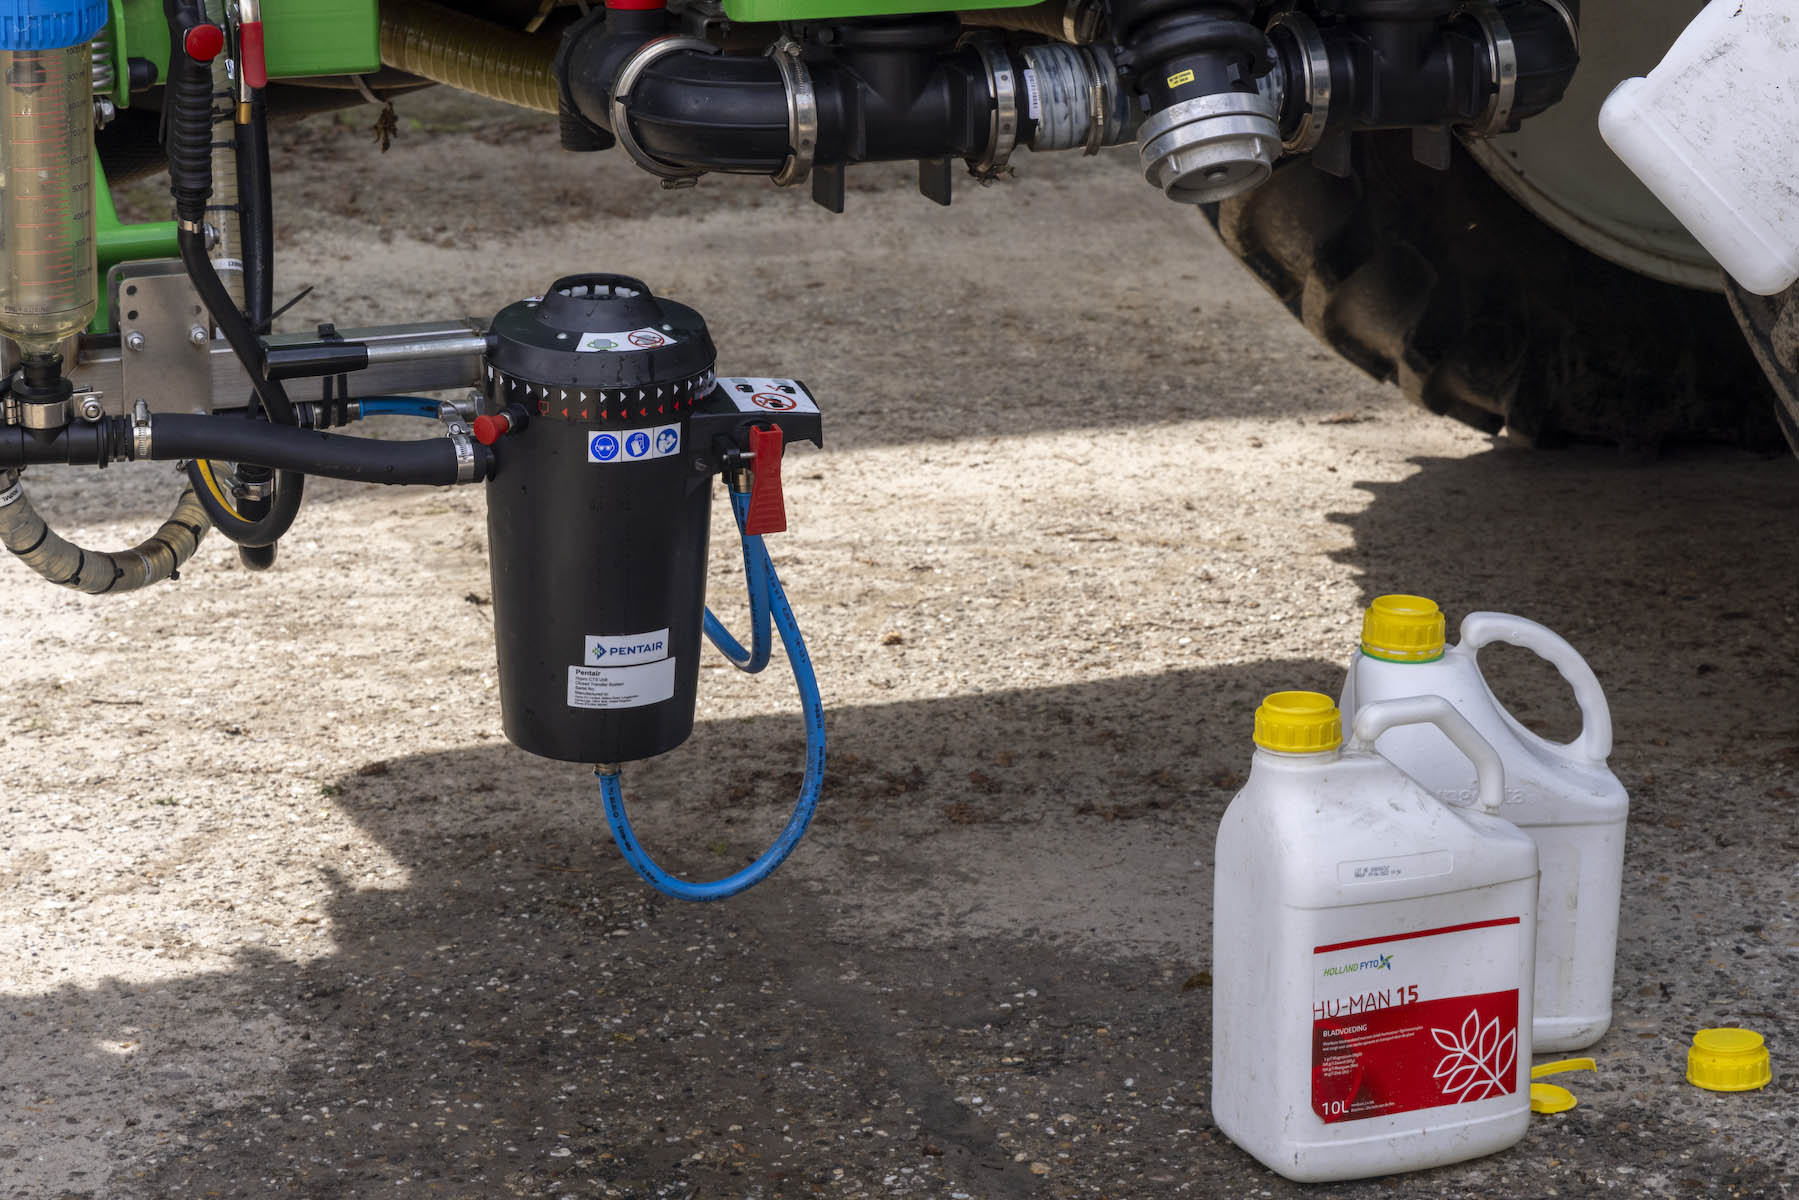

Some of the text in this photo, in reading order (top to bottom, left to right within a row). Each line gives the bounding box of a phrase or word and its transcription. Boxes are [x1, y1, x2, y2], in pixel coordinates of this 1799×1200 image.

[609, 641, 664, 656] PENTAIR
[575, 668, 601, 676] Pentair
[1323, 958, 1380, 978] HOLLAND FYTO
[1313, 984, 1419, 1020] HU-MAN 15
[1322, 1024, 1368, 1038] BLADVOEDING
[1322, 1099, 1349, 1116] 10L
